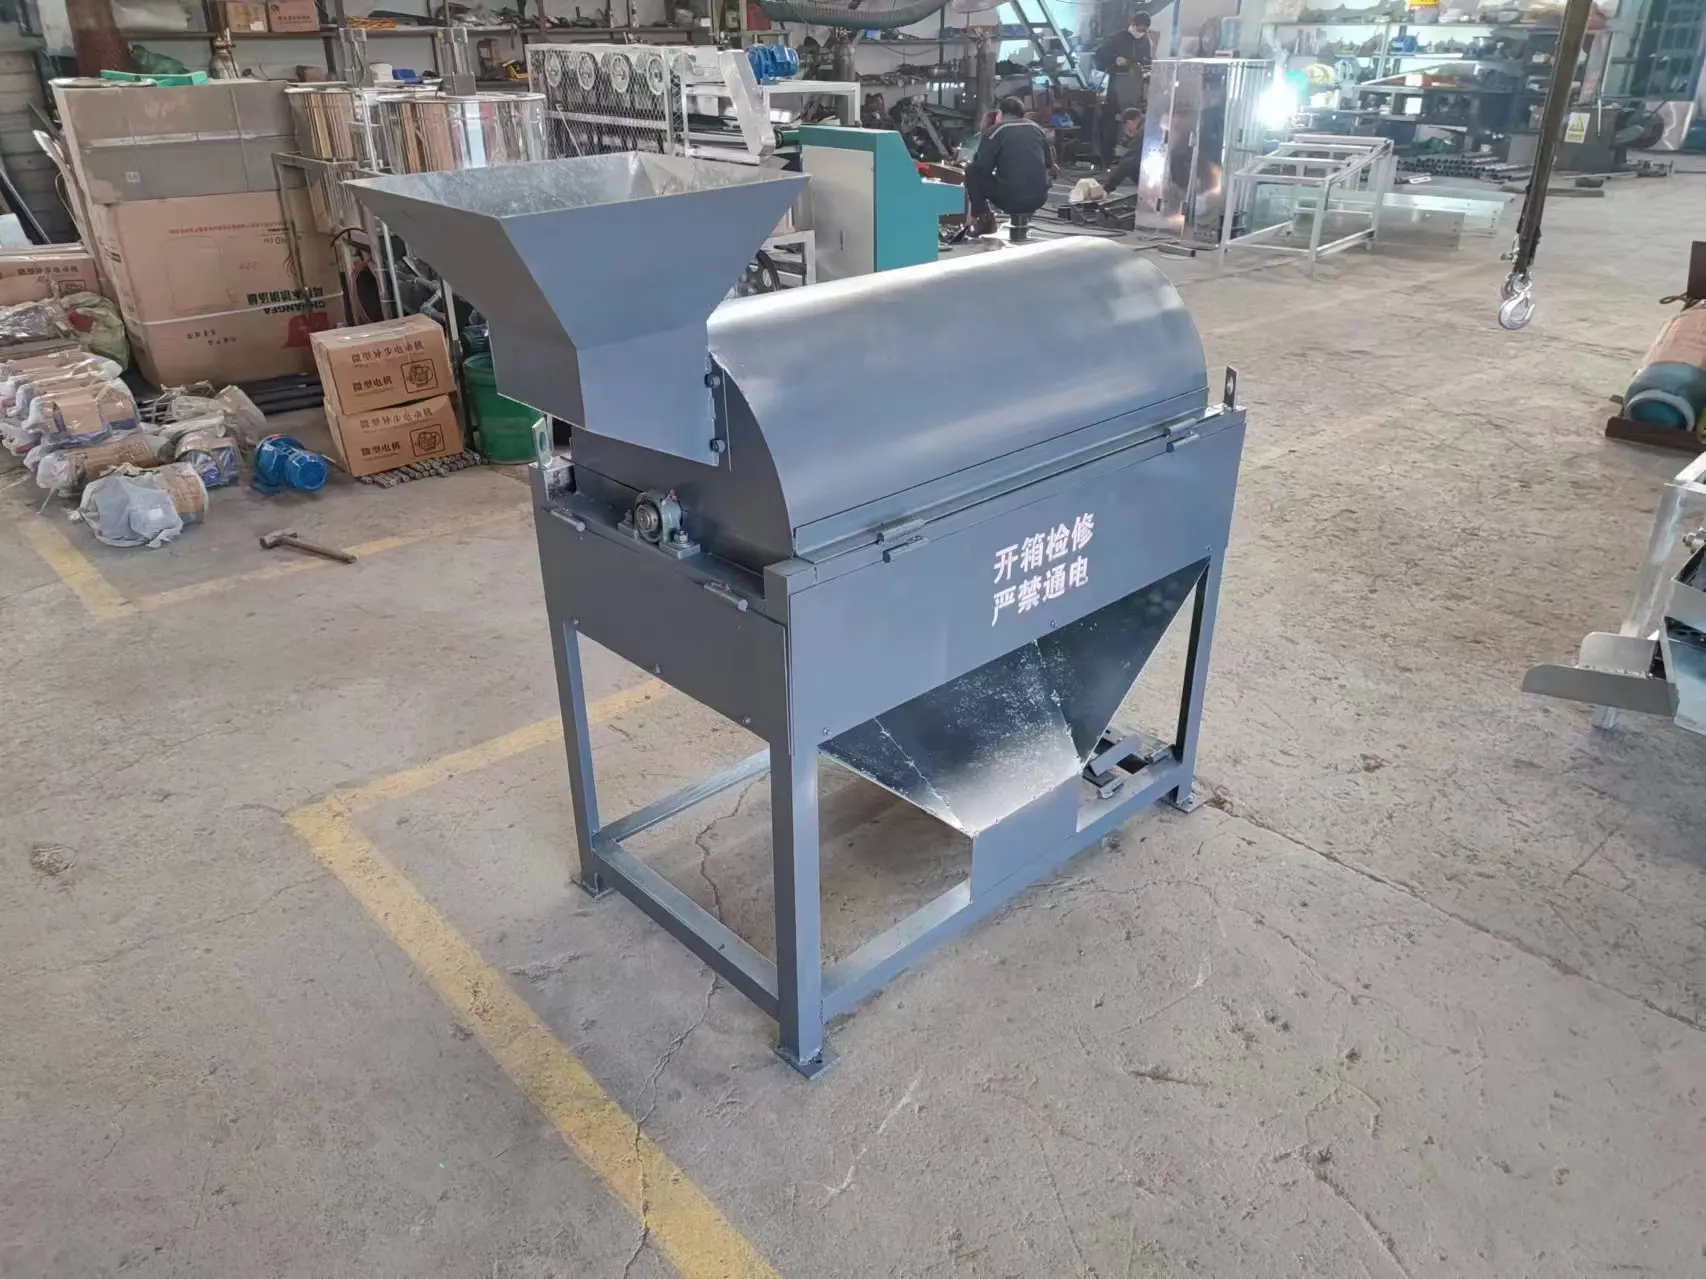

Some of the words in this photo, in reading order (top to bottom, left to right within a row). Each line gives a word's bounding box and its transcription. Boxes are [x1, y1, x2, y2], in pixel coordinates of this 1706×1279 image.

[352, 375, 393, 392] 微型电机
[361, 441, 401, 456] 微型电机
[993, 513, 1094, 584] 开箱检修
[991, 556, 1089, 627] 严禁通电
